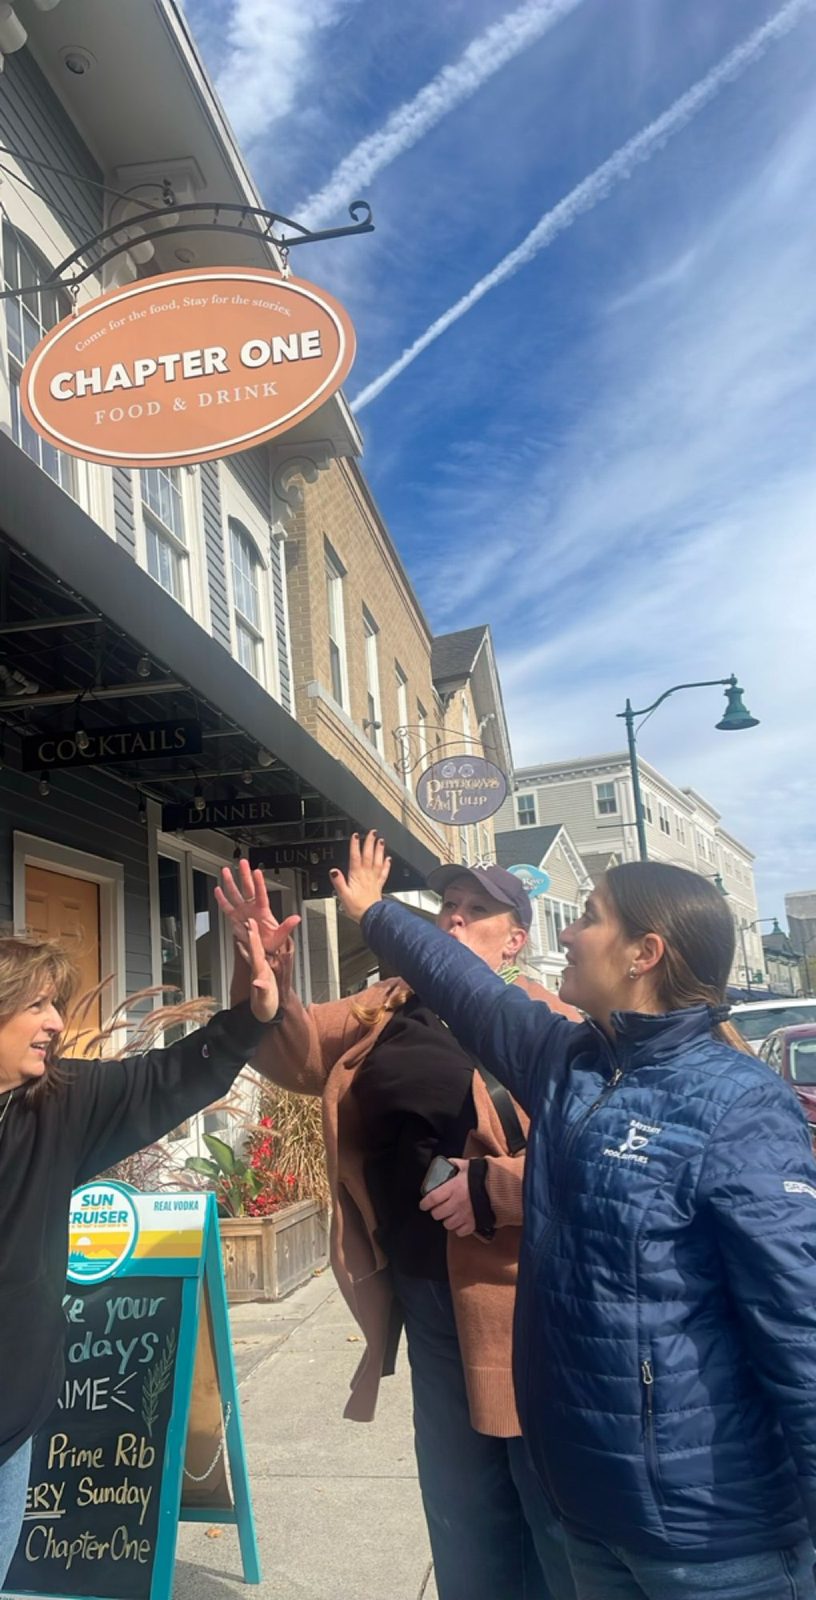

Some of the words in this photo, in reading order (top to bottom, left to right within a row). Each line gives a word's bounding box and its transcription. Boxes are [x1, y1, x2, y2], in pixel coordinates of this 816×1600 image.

[75, 327, 107, 352] Come
[109, 317, 126, 331] for
[128, 308, 147, 323] the
[149, 300, 181, 315] food,
[183, 296, 208, 308] Stay
[211, 294, 229, 305] for
[231, 295, 250, 305] the
[49, 346, 230, 401] CHAPTER
[240, 329, 323, 368] ONE
[95, 402, 161, 425] FOOD
[172, 397, 188, 412] &
[199, 381, 279, 408] DRINK
[38, 727, 187, 763] COCKTAILS
[188, 802, 273, 825] DINNER
[70, 1211, 128, 1224] RUISER
[81, 1194, 114, 1207] SUN
[154, 1201, 172, 1211] REAL
[173, 1200, 199, 1211] VODKA
[106, 1296, 167, 1335] your
[57, 1377, 110, 1411] IME
[47, 1433, 105, 1470] Prime
[115, 1433, 156, 1469] Rib
[77, 1477, 152, 1526] Sunday
